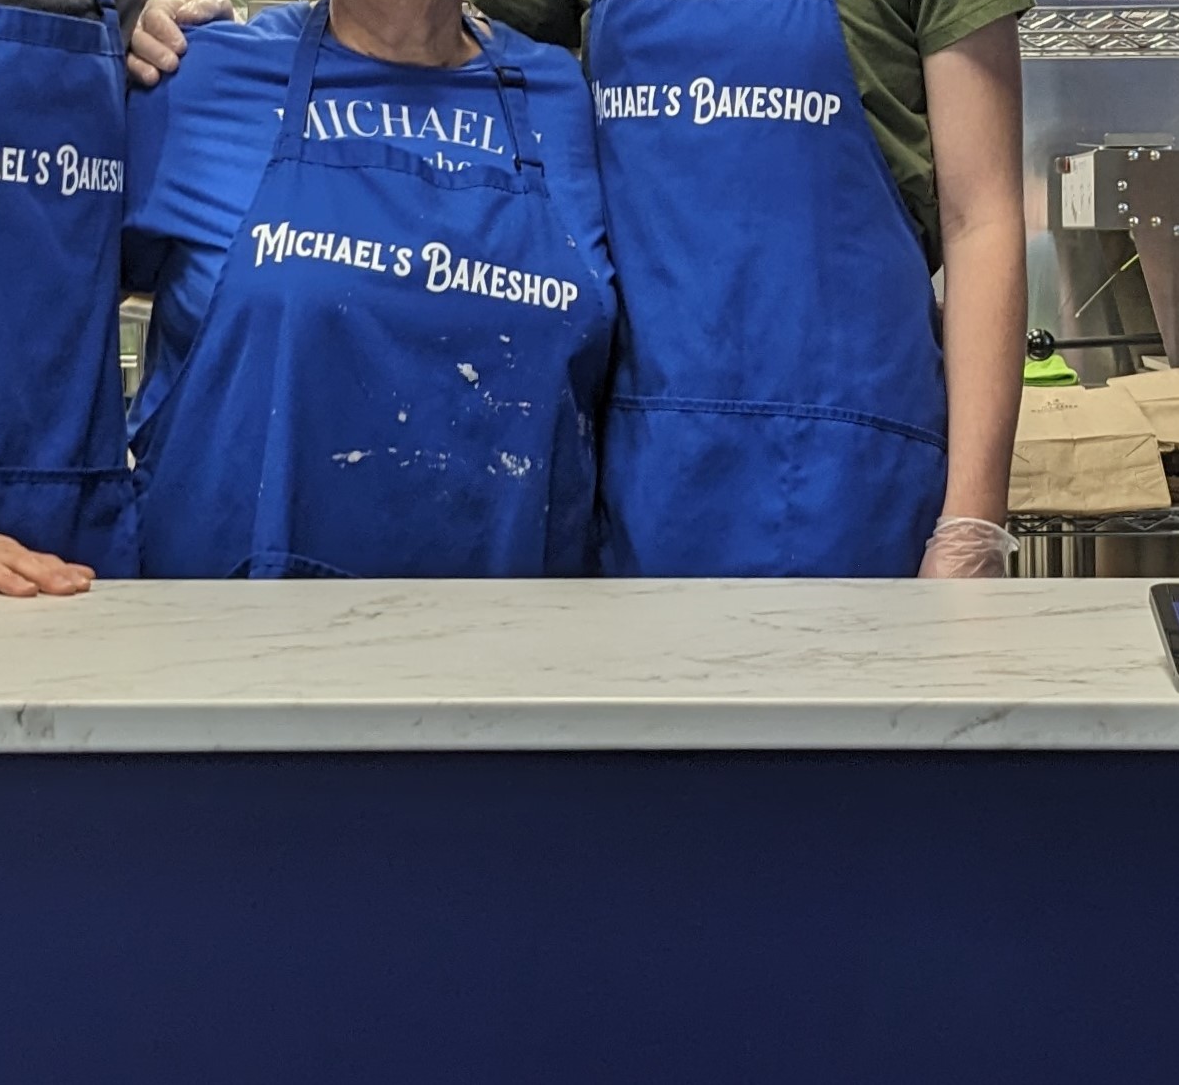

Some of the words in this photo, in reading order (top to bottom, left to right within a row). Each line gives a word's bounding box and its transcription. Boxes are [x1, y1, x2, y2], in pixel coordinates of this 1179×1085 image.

[689, 76, 842, 126] BAKESHOP
[252, 221, 413, 278] MICHAEL'S
[421, 241, 579, 312] BAKESHOP
